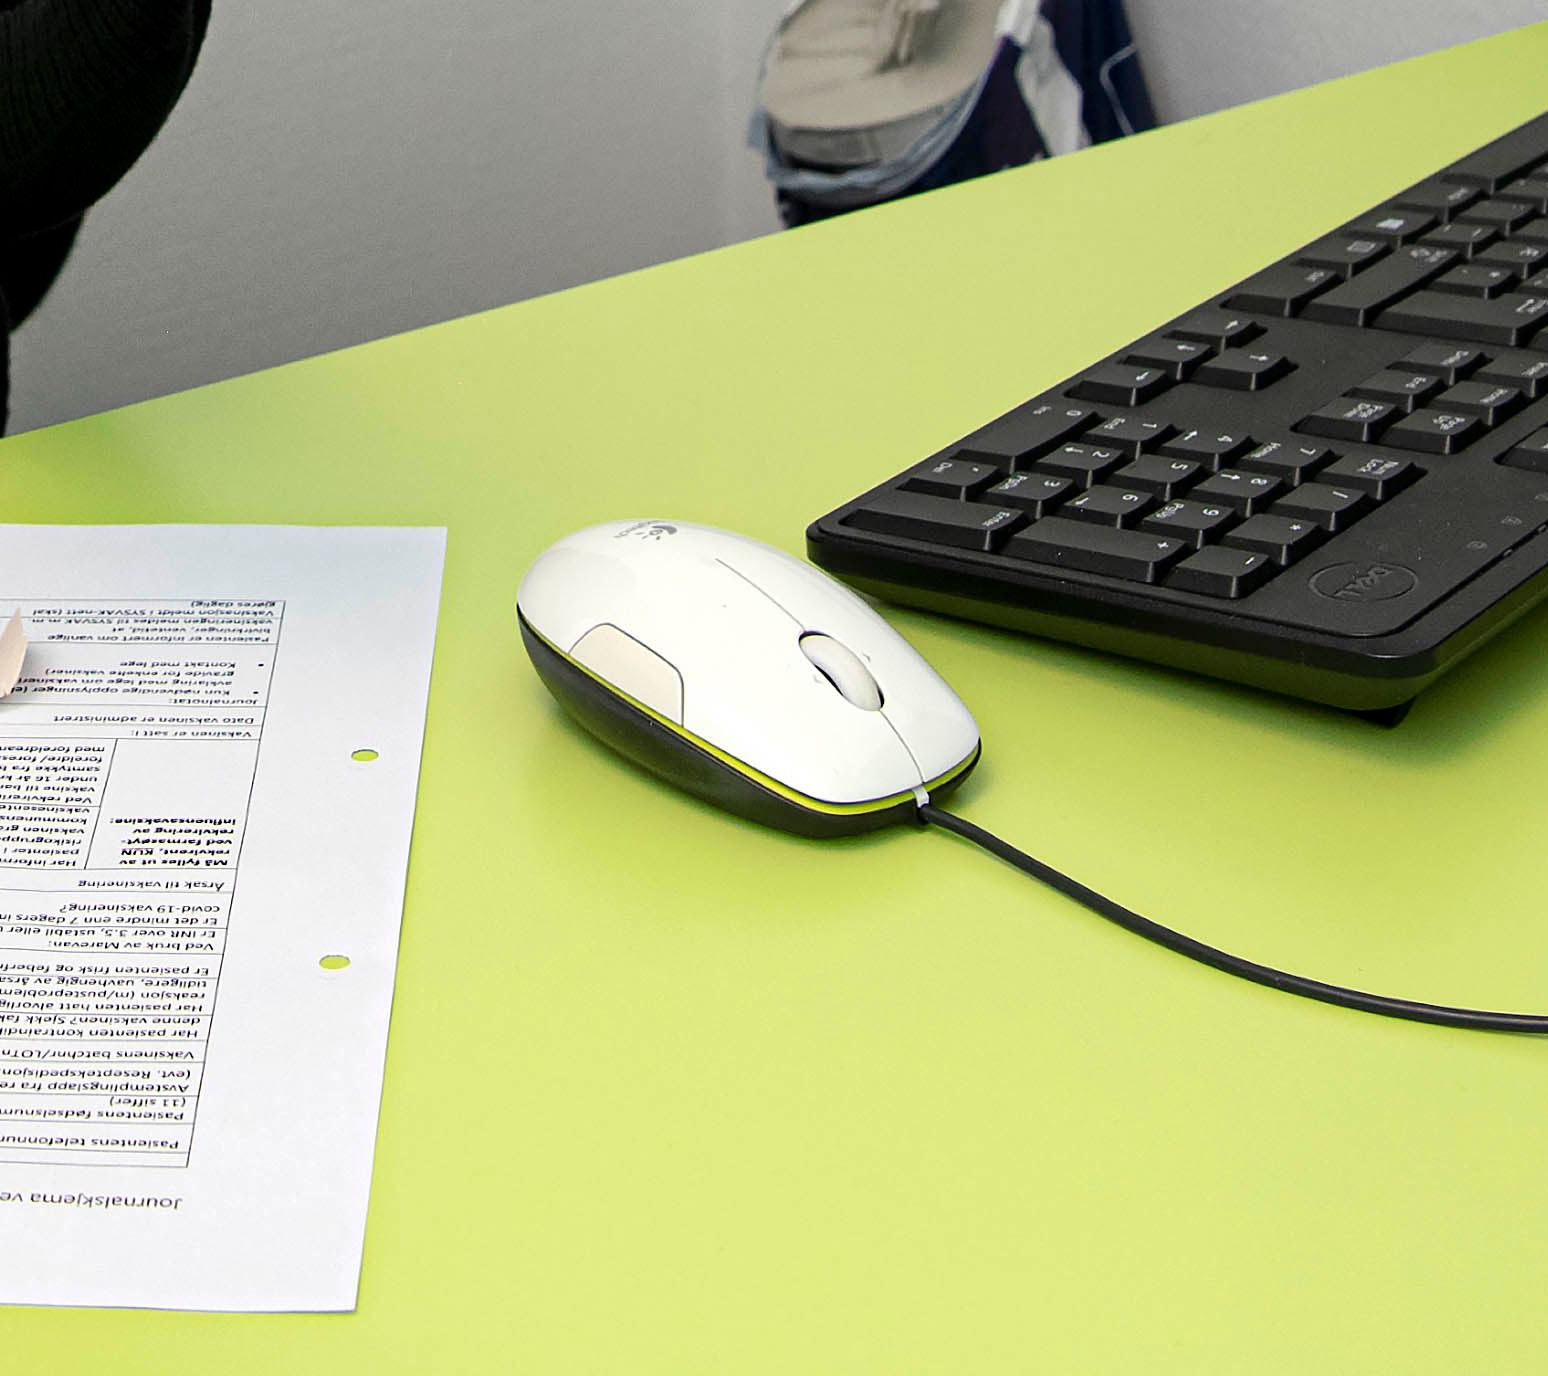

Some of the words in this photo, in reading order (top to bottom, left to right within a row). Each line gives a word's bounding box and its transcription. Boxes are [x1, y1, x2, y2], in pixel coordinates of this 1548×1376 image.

[1217, 434, 1233, 442] 4
[1093, 450, 1109, 458] 2
[1300, 448, 1316, 456] 7
[1171, 462, 1188, 470] 5
[1044, 480, 1060, 488] 3
[1252, 477, 1267, 485] 8
[1122, 494, 1138, 502] 6
[1203, 507, 1218, 516] 9
[982, 511, 1010, 527] Enter
[1333, 566, 1393, 599] DELL
[53, 716, 137, 725] administrert
[158, 717, 218, 726] vaksinen
[221, 717, 254, 726] Dato
[77, 878, 161, 890] vaksinering
[164, 881, 179, 890] til
[183, 881, 224, 890] Årsak
[58, 902, 152, 914] vaksinering?
[156, 906, 220, 915] covid-19
[7, 927, 41, 936] eller
[44, 928, 95, 938] ustabil
[170, 930, 196, 940] INR
[200, 931, 215, 940] Er
[25, 1013, 65, 1024] Sjekk
[69, 1016, 147, 1026] vaksinen?
[151, 1017, 200, 1026] denne
[88, 1026, 166, 1038] pasienten
[170, 1030, 197, 1039] Har
[116, 1051, 194, 1061] Vaksinens
[157, 1068, 190, 1081] (evt.
[20, 1080, 41, 1090] fra
[47, 1078, 189, 1094] Avstemplingslapp
[108, 1095, 156, 1108] siffer)
[162, 1096, 186, 1108] (11
[96, 1110, 183, 1121] Pasientens
[90, 1138, 178, 1150] Pasientens
[29, 1191, 182, 1211] Journalskjema
